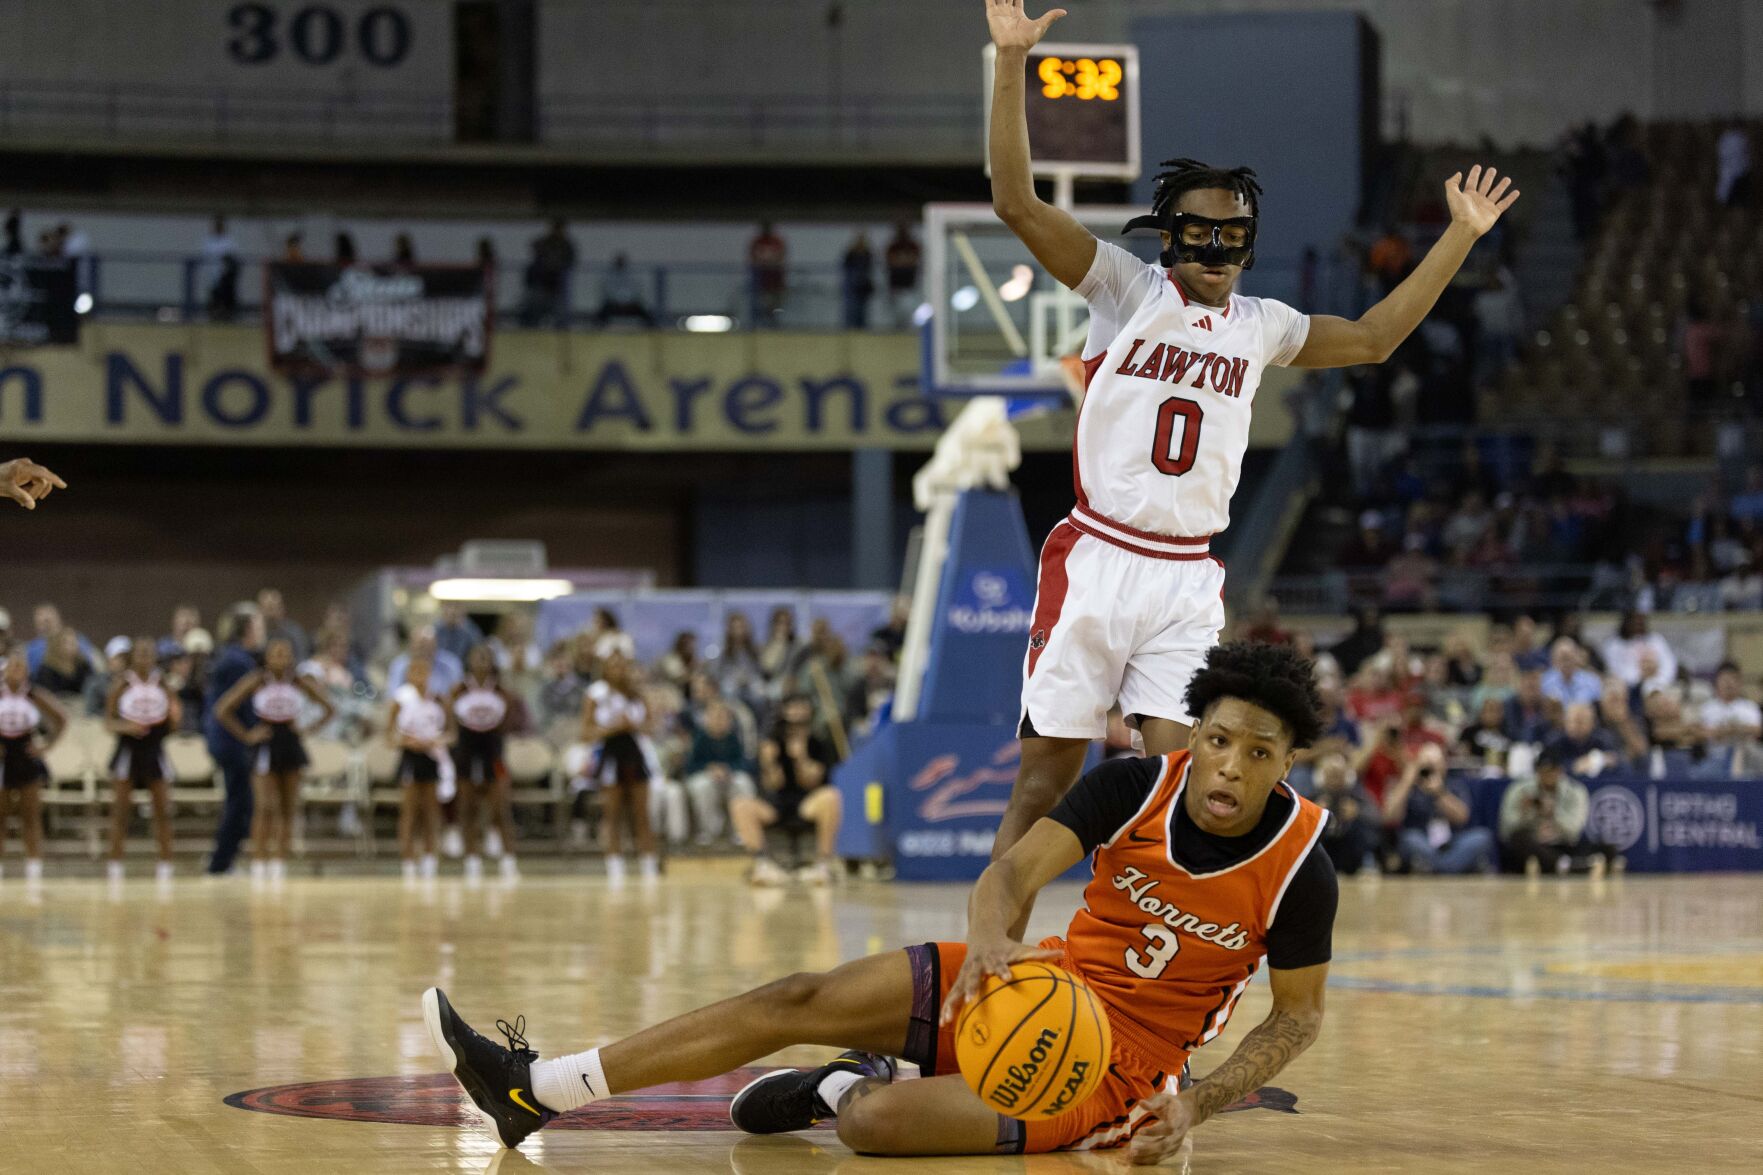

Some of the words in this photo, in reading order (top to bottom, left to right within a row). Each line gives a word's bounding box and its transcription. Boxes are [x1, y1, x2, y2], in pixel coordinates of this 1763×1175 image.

[227, 3, 413, 67] 300
[1038, 57, 1122, 100] 5:32
[106, 352, 525, 431] Norick
[575, 356, 949, 434] Arena
[1115, 338, 1249, 398] LAWTON
[1150, 396, 1204, 477] 0
[1111, 866, 1251, 951] Hornets
[1125, 923, 1181, 979] 3
[990, 1028, 1059, 1108] Wilson
[1041, 1061, 1090, 1115] NCAA
